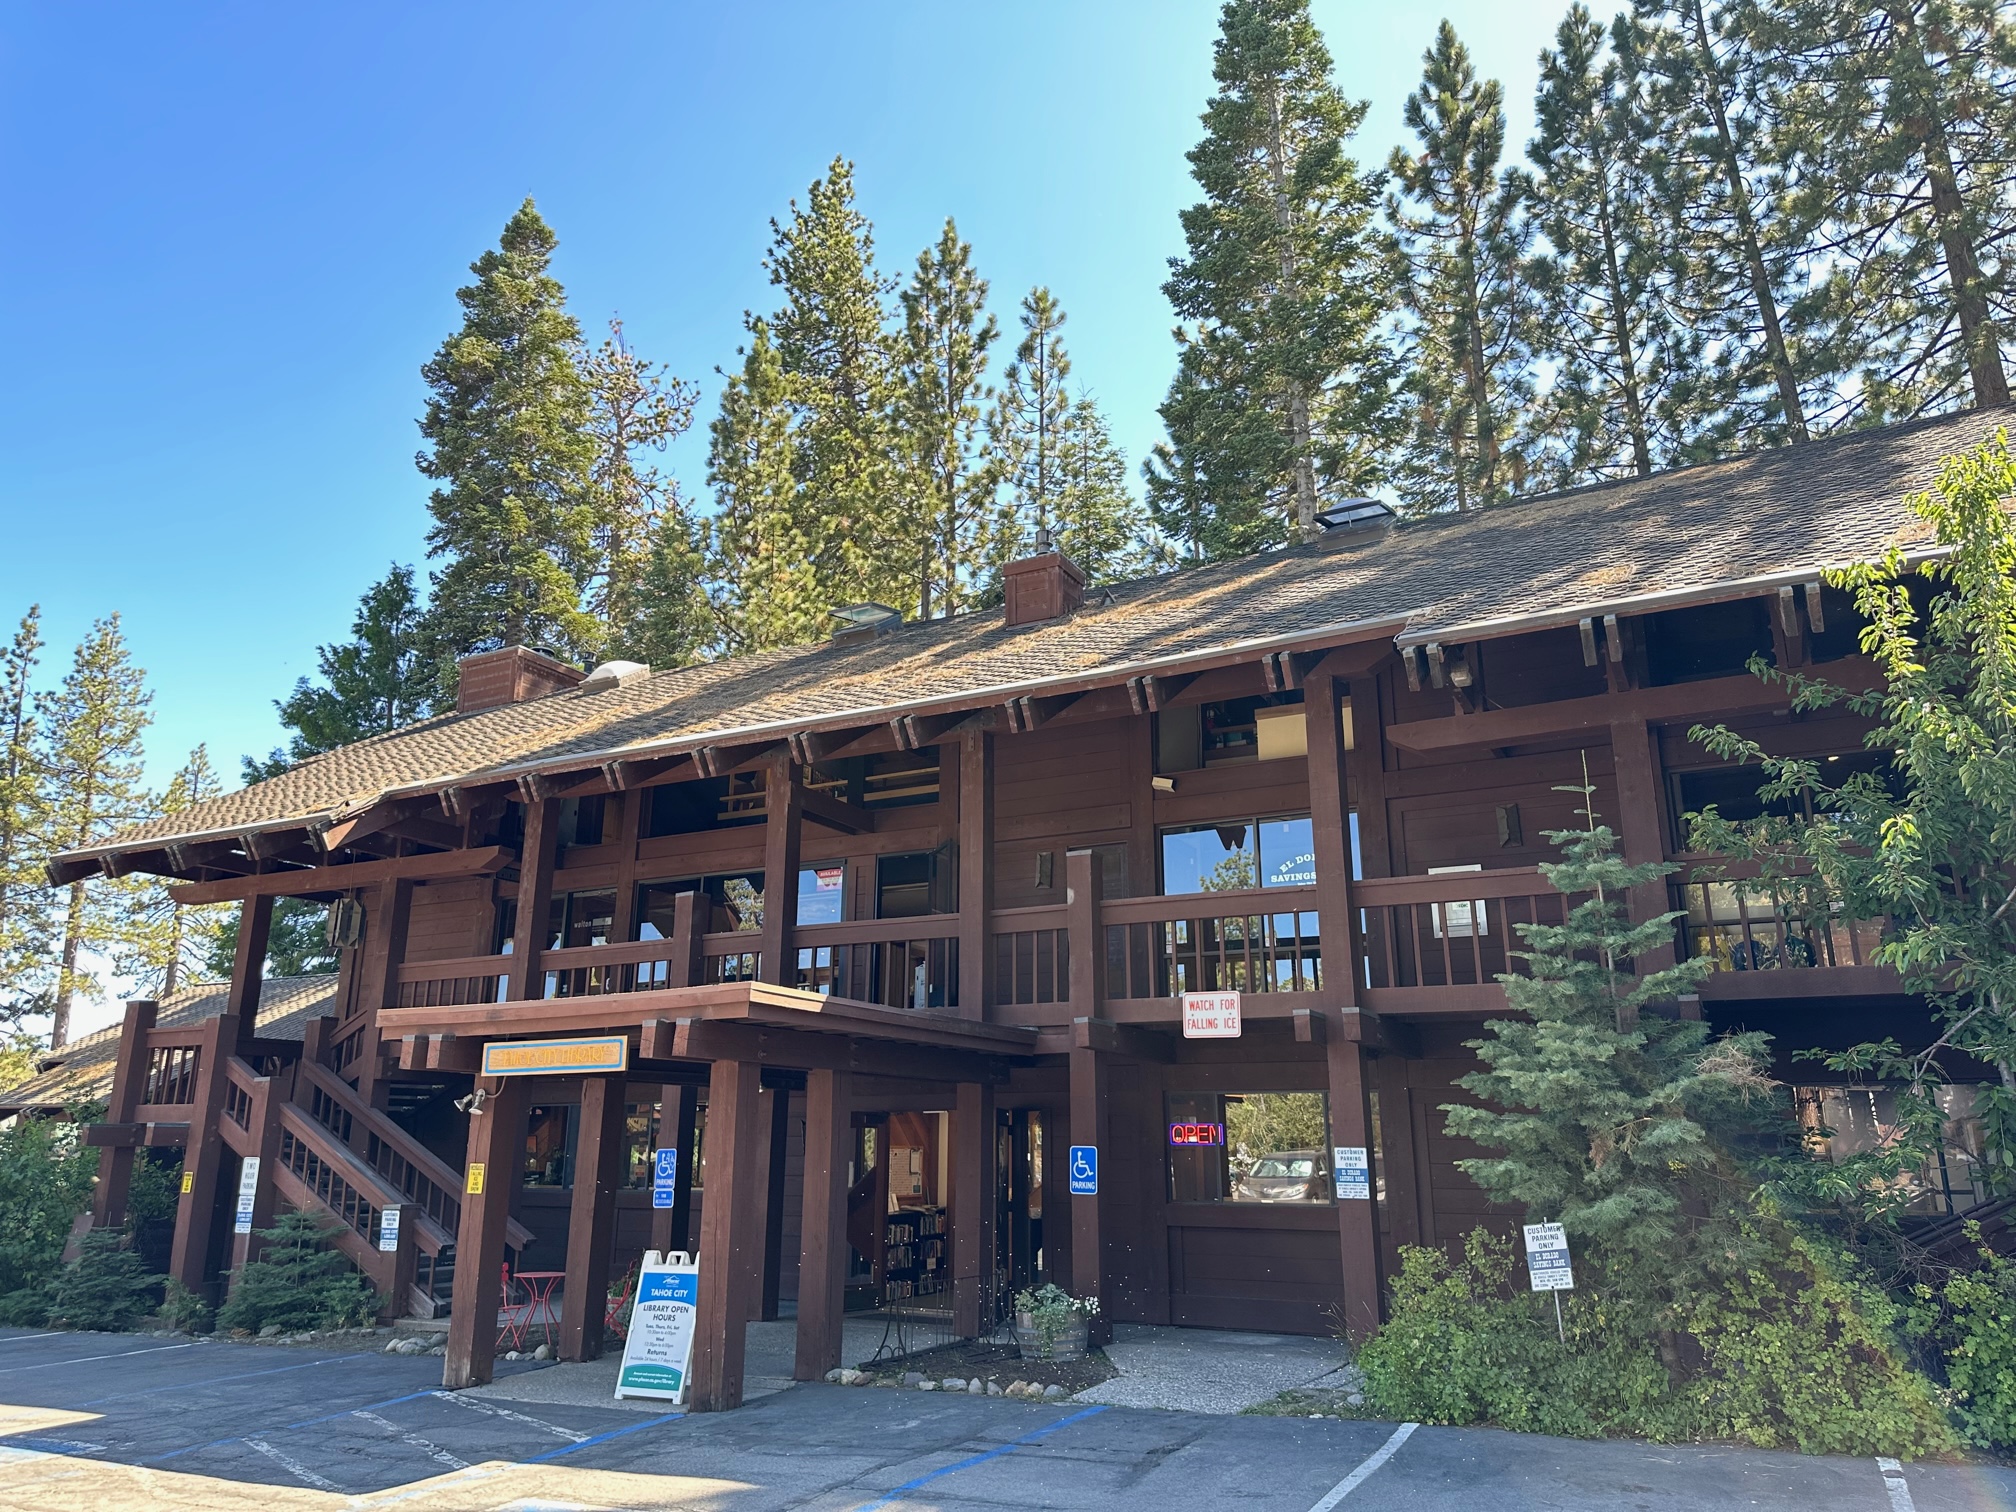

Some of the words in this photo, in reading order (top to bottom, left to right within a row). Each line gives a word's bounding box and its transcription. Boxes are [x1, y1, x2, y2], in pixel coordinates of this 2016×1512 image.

[1279, 860, 1294, 873] EL
[1271, 872, 1316, 882] SAVINGS
[1189, 1000, 1214, 1011] WATCH
[1220, 999, 1235, 1010] FOR
[1188, 1018, 1218, 1030] FALLING
[1224, 1018, 1236, 1029] ICE
[534, 1048, 558, 1064] CITY
[561, 1046, 606, 1063] LIBRARY
[1172, 1125, 1221, 1143] OPEN
[1072, 1181, 1095, 1190] PARKING
[1528, 1226, 1561, 1234] CUSTOMER
[1532, 1234, 1559, 1242] PARKING
[651, 1288, 673, 1297] TAHOE
[643, 1304, 670, 1313] LIBRARY
